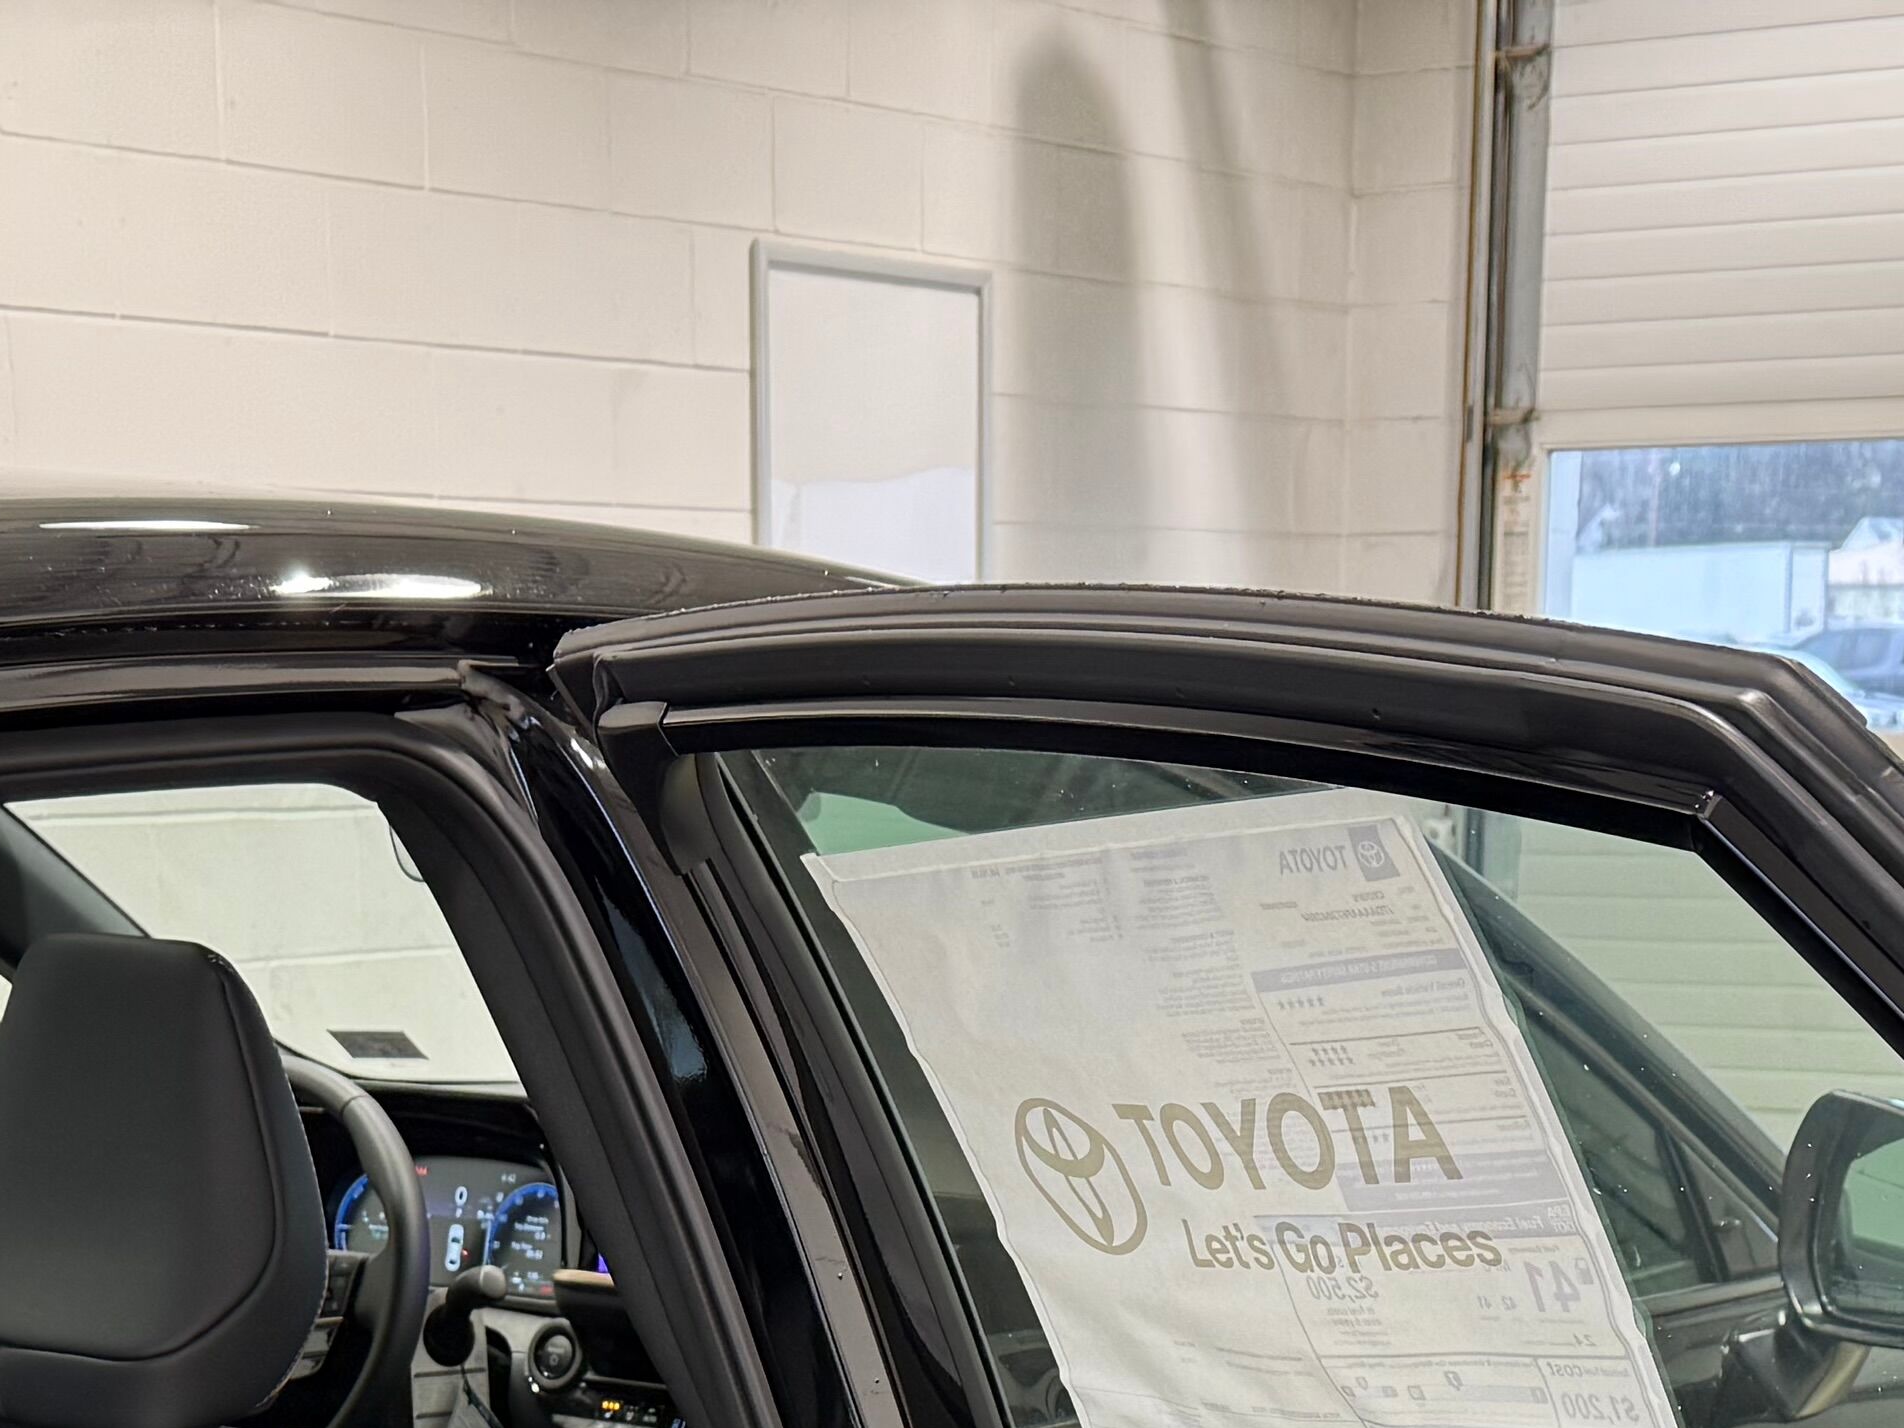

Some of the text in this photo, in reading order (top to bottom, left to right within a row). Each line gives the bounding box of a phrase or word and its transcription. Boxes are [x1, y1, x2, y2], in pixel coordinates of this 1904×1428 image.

[1112, 1085, 1462, 1191] TOYOTA
[1182, 1218, 1502, 1275] Let's Go Places
